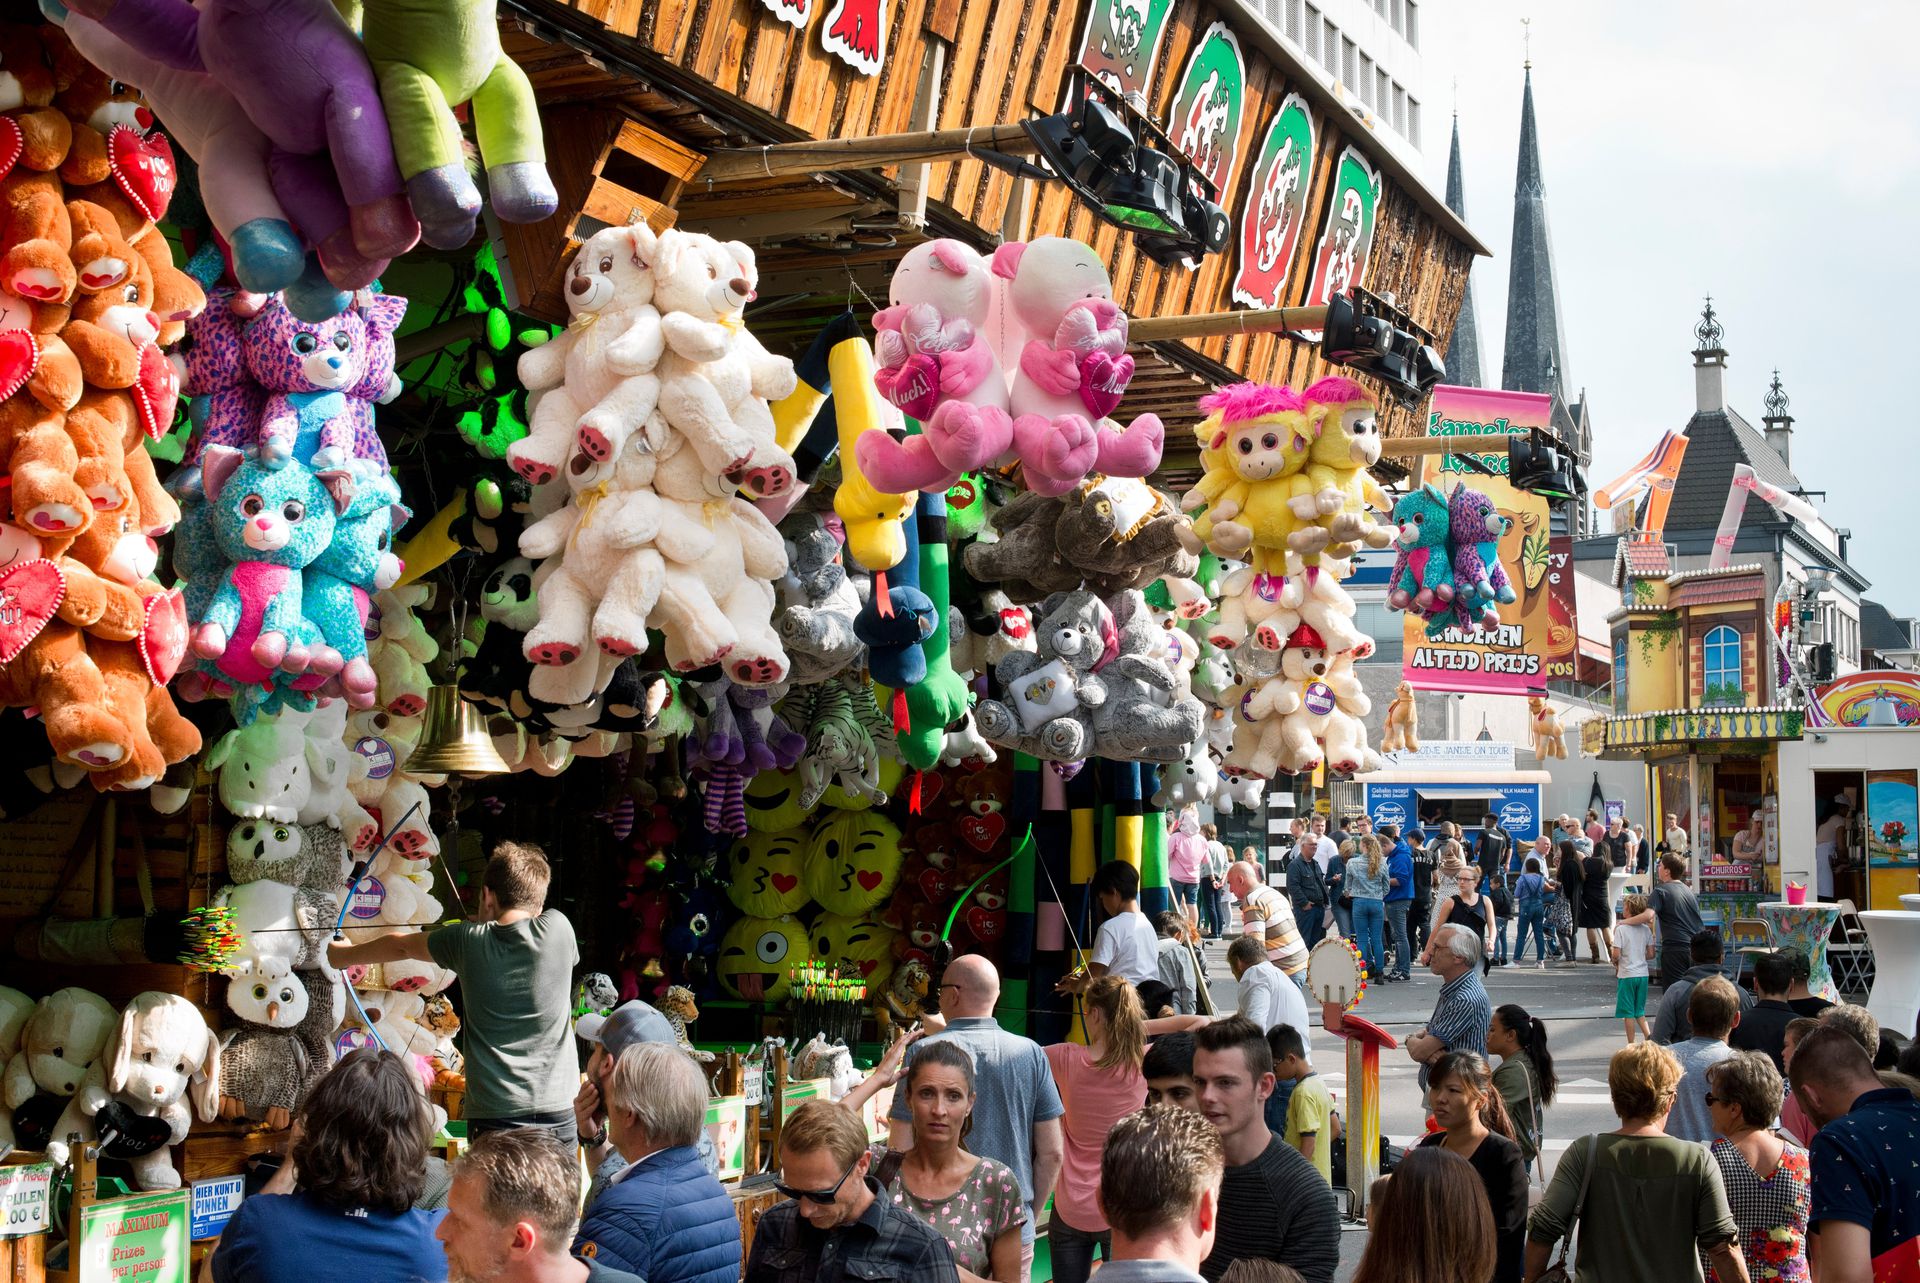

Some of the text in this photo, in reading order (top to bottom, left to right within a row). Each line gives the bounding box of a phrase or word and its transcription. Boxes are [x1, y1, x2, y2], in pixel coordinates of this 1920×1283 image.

[1412, 648, 1540, 675] ALTIJD PRIJS
[1711, 865, 1743, 875] CHURROS
[195, 1180, 241, 1199] HIER KUNT U
[195, 1195, 229, 1215] PINNEN
[105, 1212, 169, 1238] MAXIMUM
[112, 1245, 146, 1262] Prizes
[112, 1258, 167, 1281] per person
